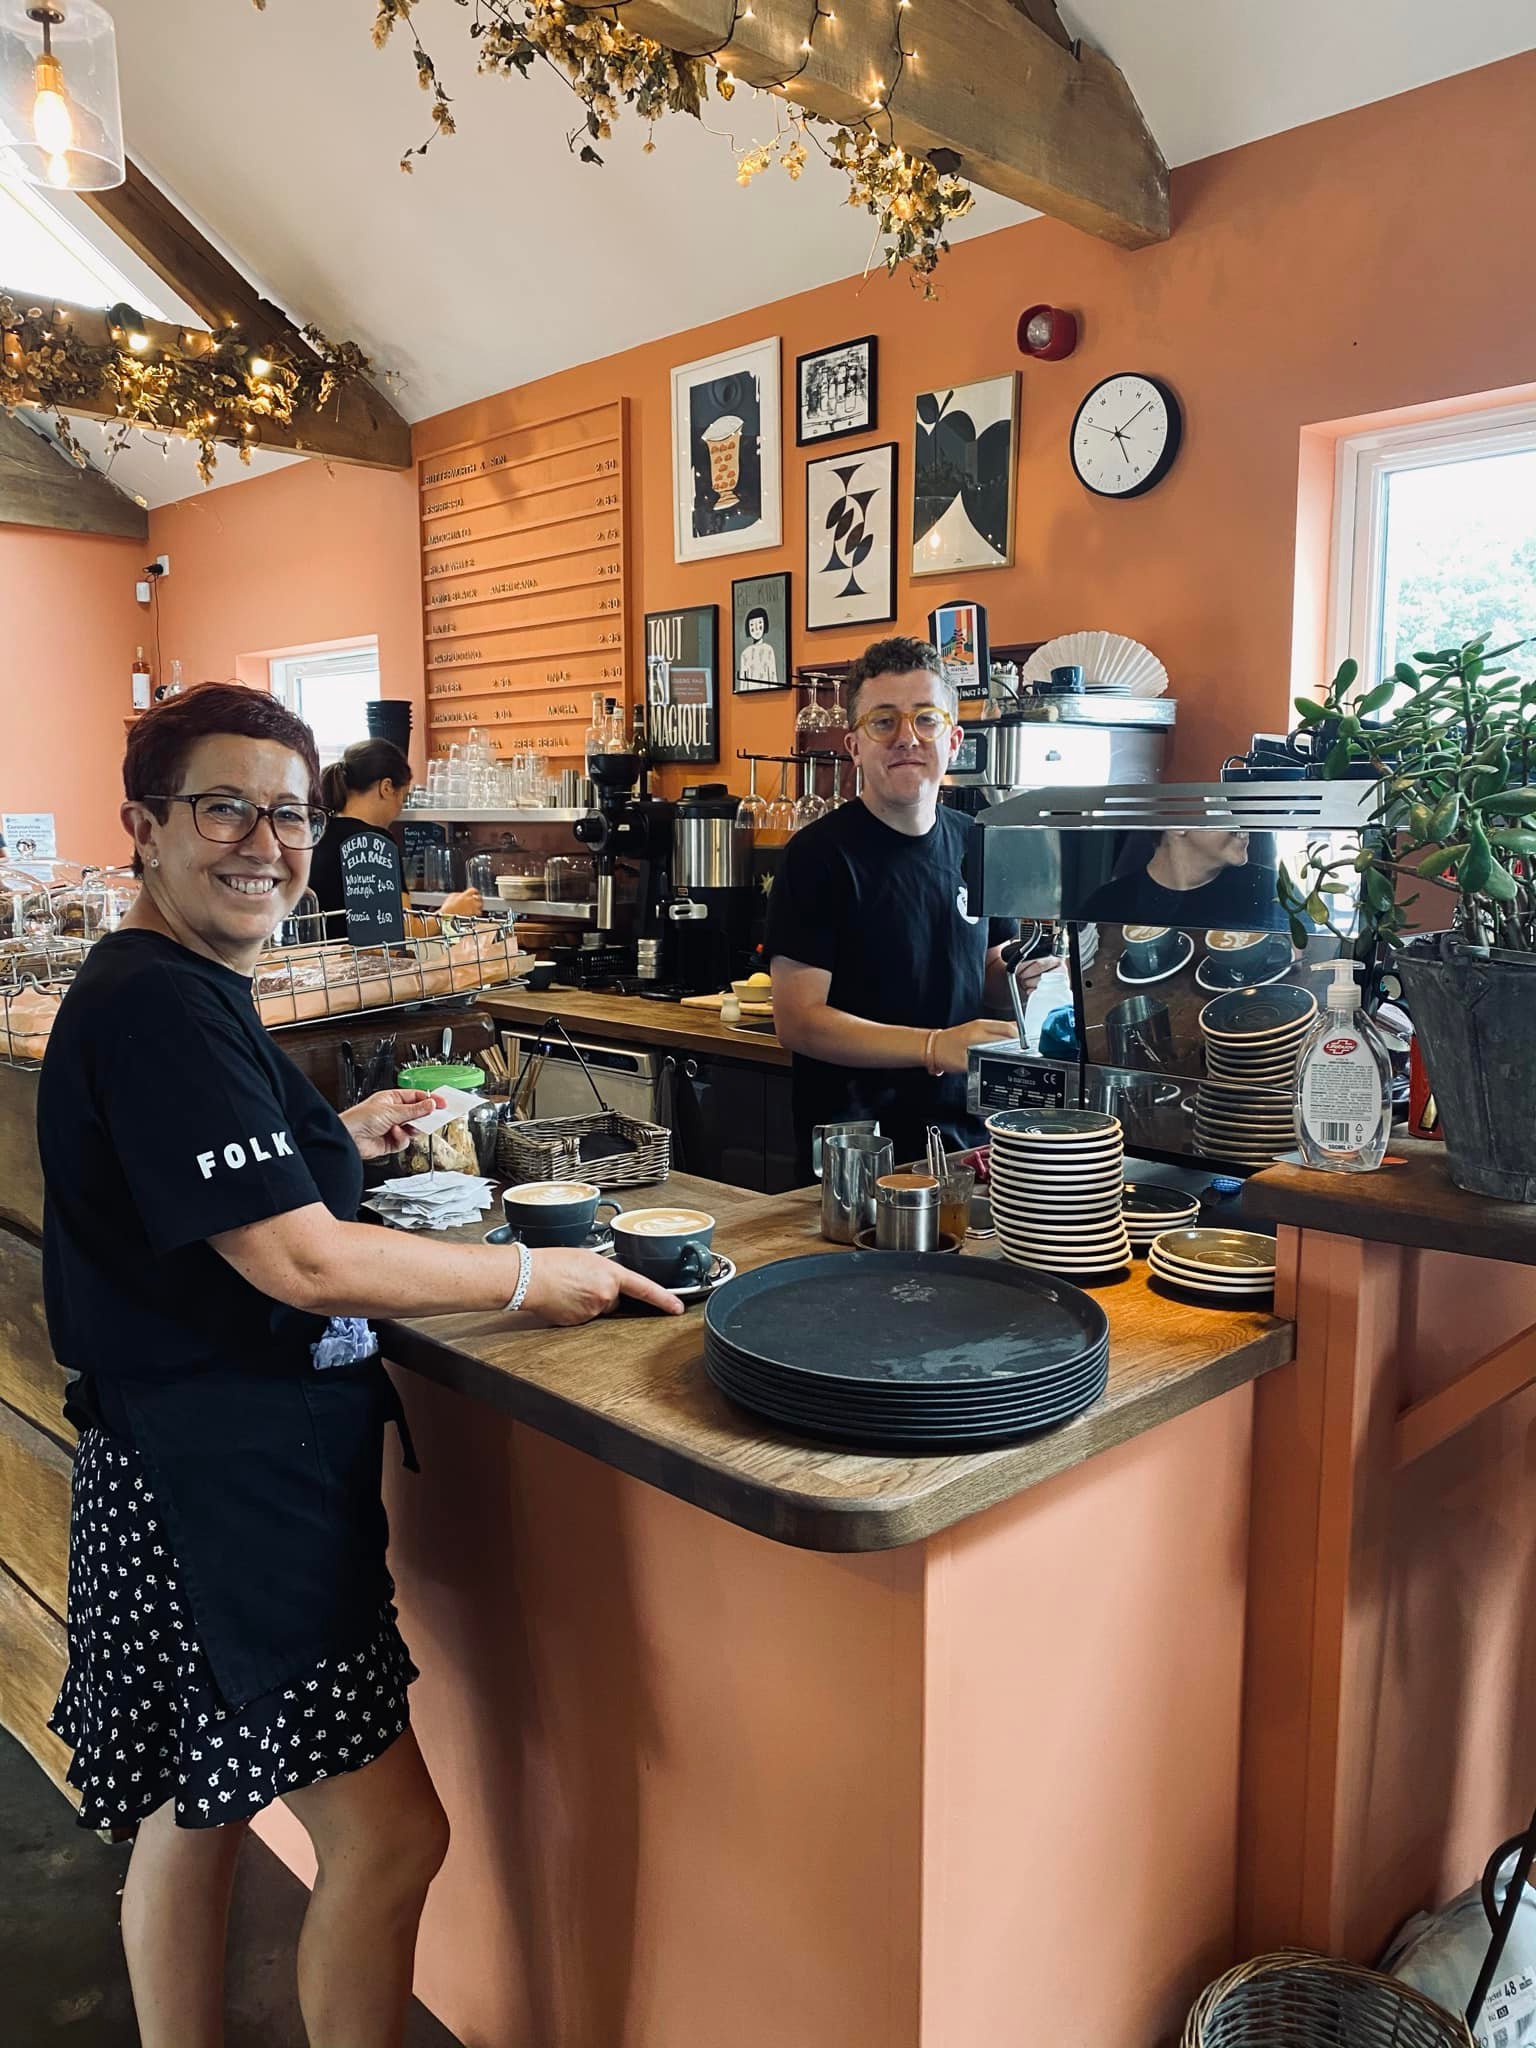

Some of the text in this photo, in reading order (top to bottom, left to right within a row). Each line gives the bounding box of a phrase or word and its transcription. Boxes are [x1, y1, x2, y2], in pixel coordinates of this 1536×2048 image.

[648, 616, 684, 662] TOUT
[649, 661, 672, 706] EST
[650, 703, 711, 754] MAGIQUE
[342, 836, 386, 859] BREAD BY
[347, 850, 393, 869] ELLA BAKES
[196, 1131, 294, 1179] FOLK
[1504, 1980, 1517, 1997] 48
